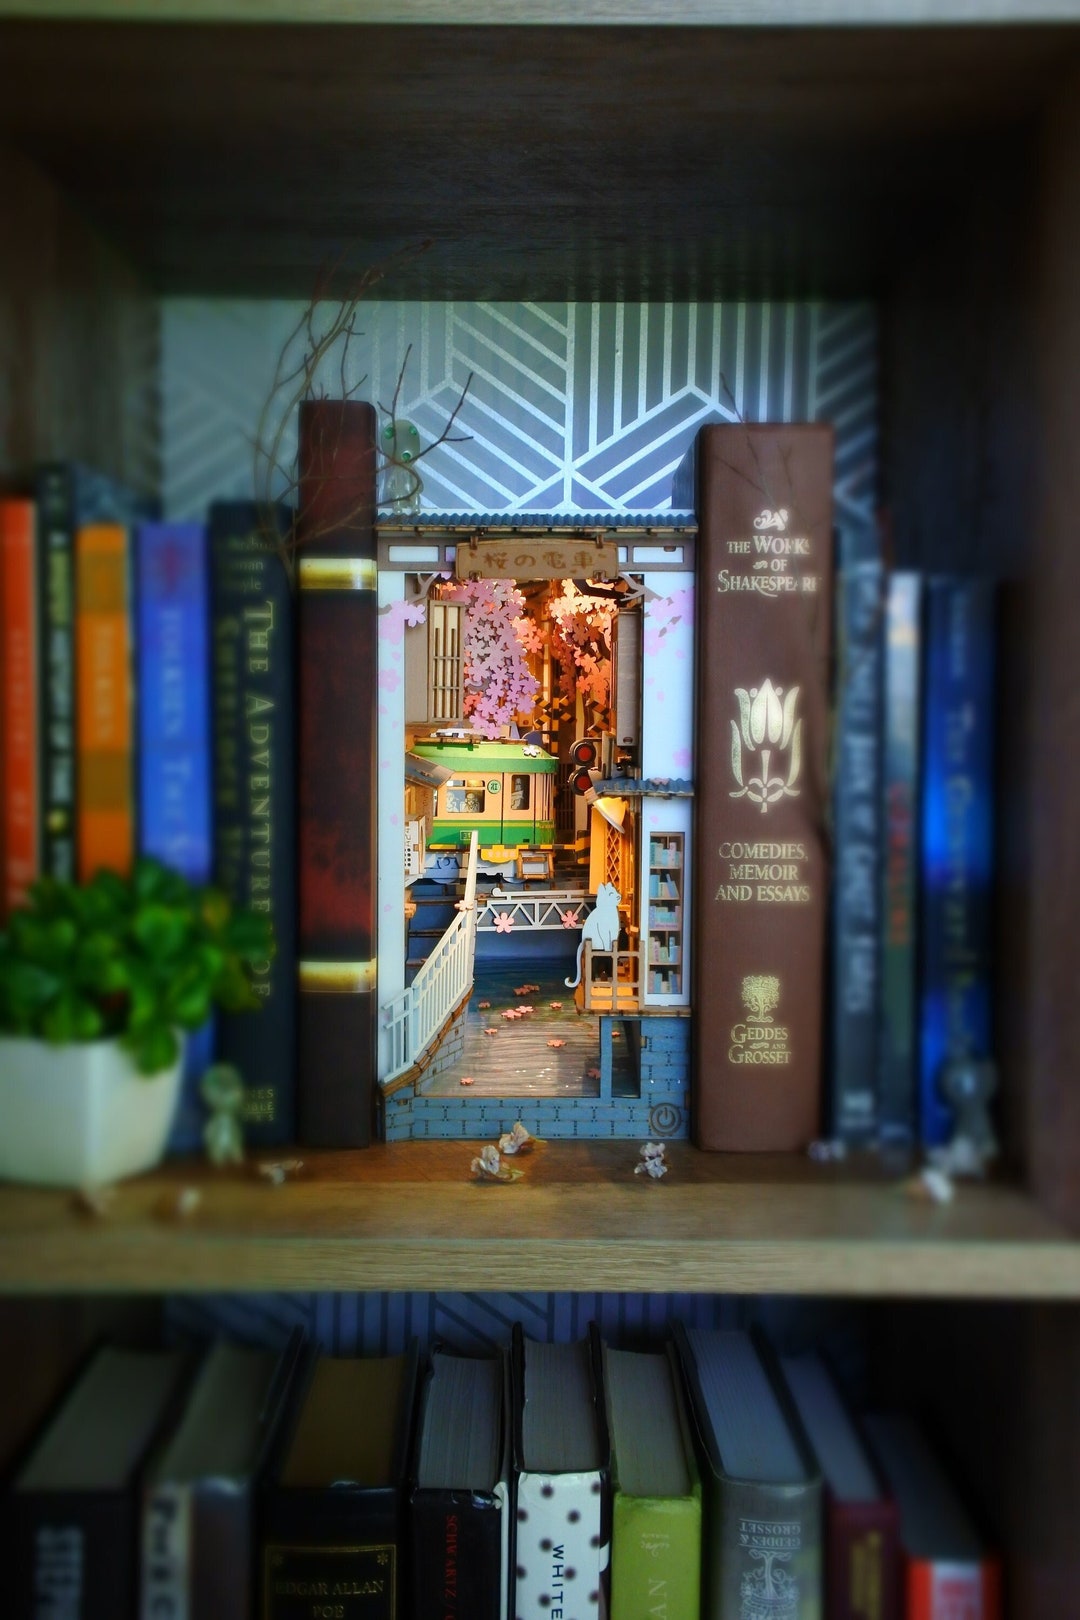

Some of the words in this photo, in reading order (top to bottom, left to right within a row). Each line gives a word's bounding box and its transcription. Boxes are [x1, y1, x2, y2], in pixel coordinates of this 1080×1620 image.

[726, 541, 751, 554] THE
[770, 559, 788, 572] OF
[245, 600, 274, 673] THE
[246, 693, 275, 928] ADVENTURE
[718, 842, 809, 861] COMEDIES,
[729, 864, 799, 881] MEMOIR
[715, 885, 753, 901] AND
[757, 885, 811, 902] ESSAYS
[730, 1024, 788, 1043] GEDDES
[728, 1044, 791, 1064] GROSSET
[740, 1521, 801, 1536] GROSSET
[752, 1534, 801, 1548] GEDDES
[444, 1514, 459, 1599] SCHWARTZ
[275, 1580, 328, 1596] EDGAR
[332, 1579, 385, 1595] ALLAN
[551, 1544, 565, 1619] WHITE
[311, 1604, 345, 1620] POE
